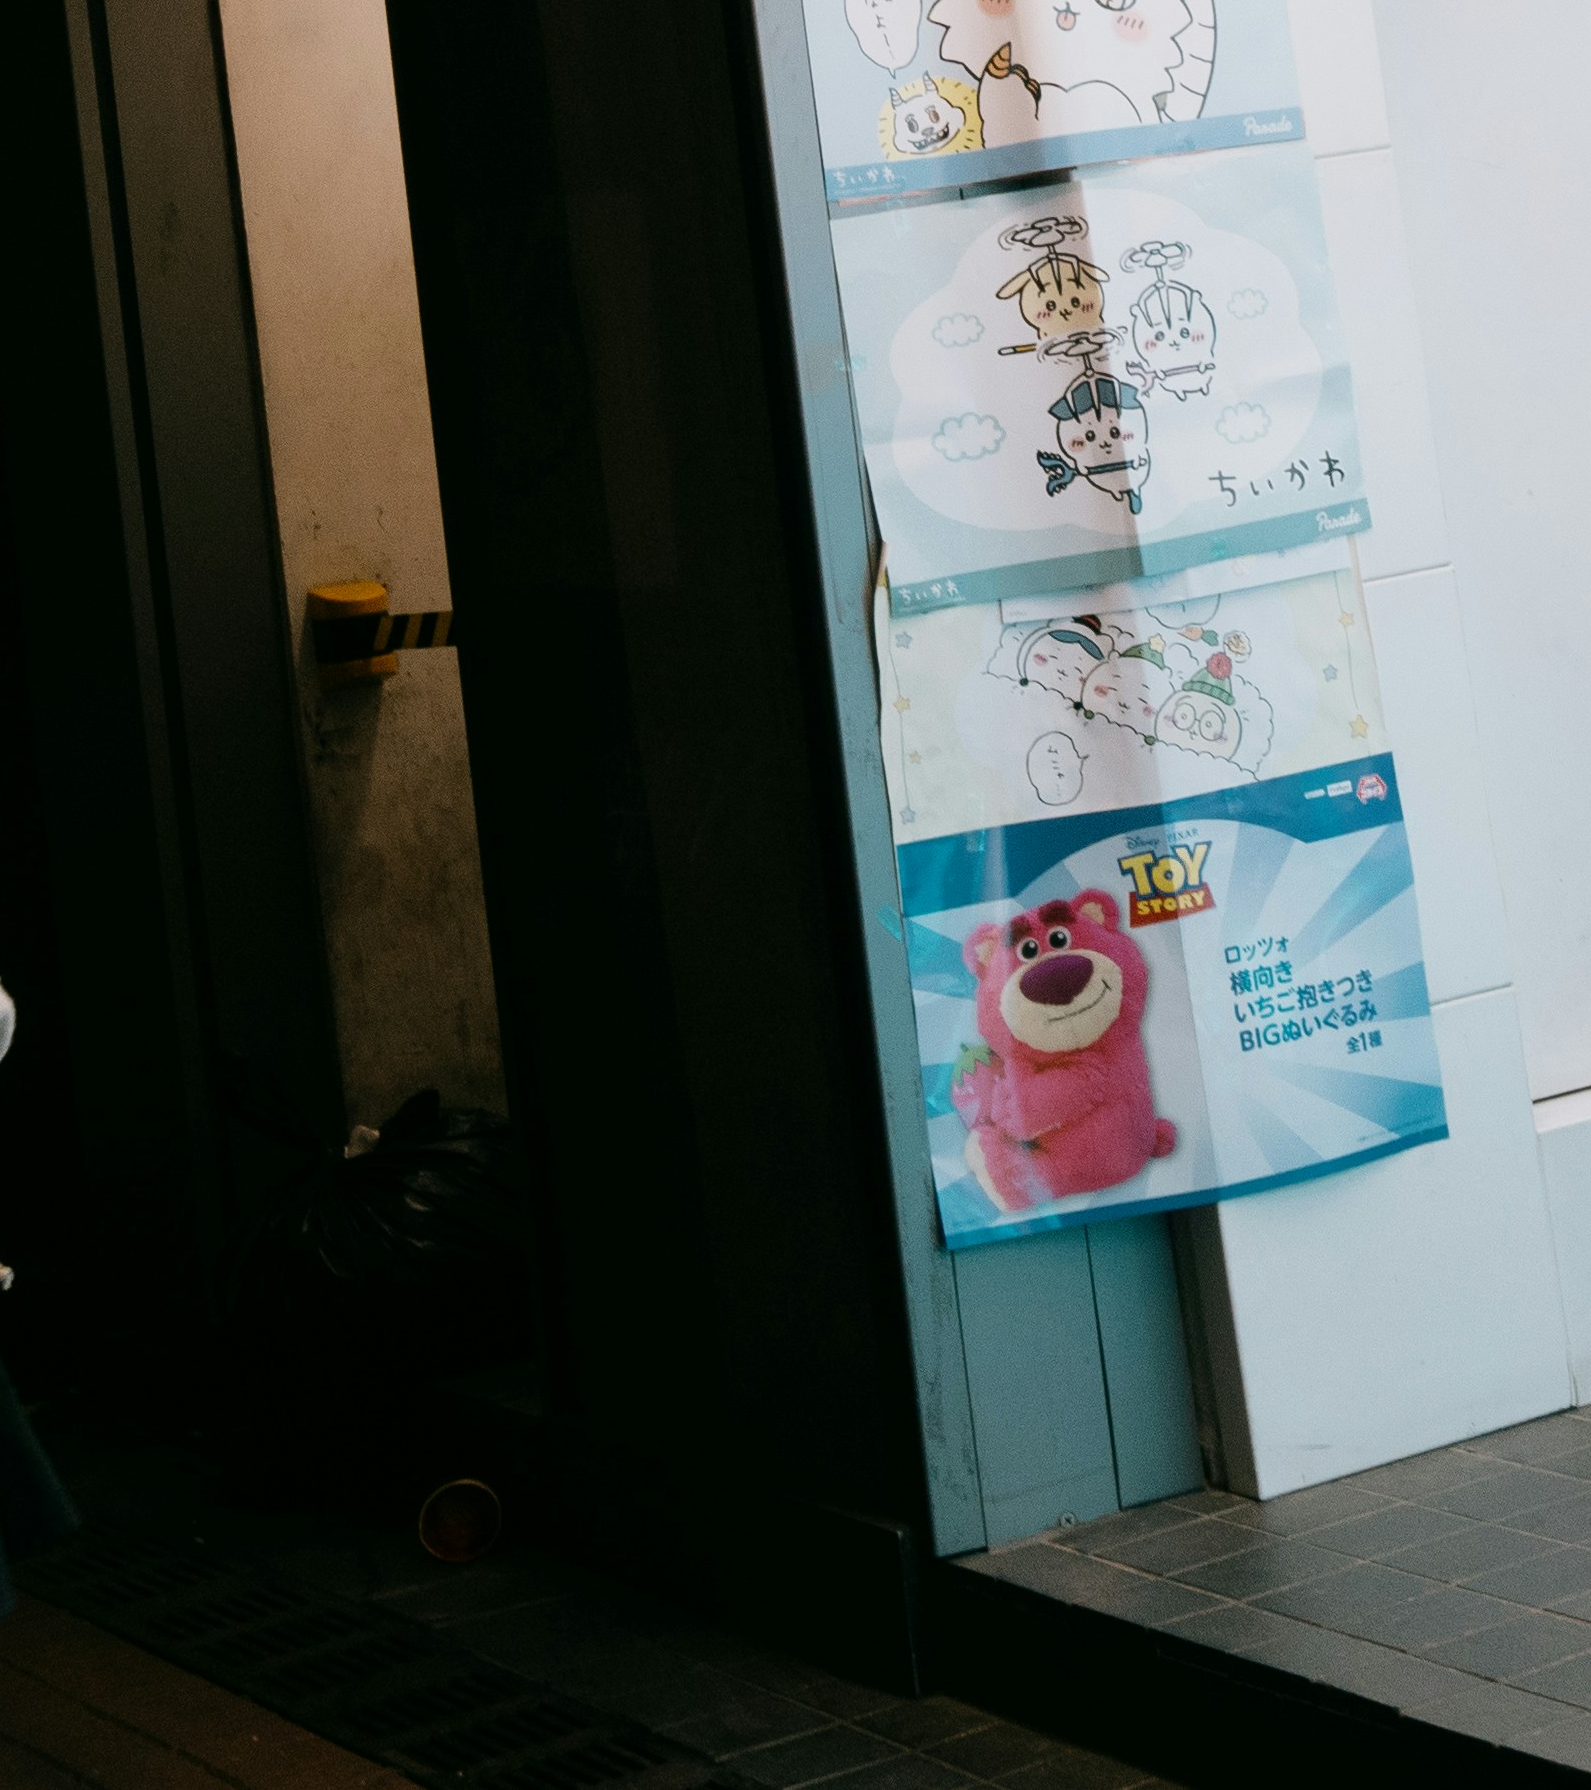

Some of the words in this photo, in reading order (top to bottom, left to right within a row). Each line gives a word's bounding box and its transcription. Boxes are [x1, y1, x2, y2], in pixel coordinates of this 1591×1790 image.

[1208, 451, 1345, 508] ちいかわ
[1119, 842, 1210, 898] TOY
[1137, 891, 1206, 916] STORY
[1234, 970, 1373, 1023] いちご抱きつき
[1240, 1000, 1377, 1052] BIGぬいぐるみ
